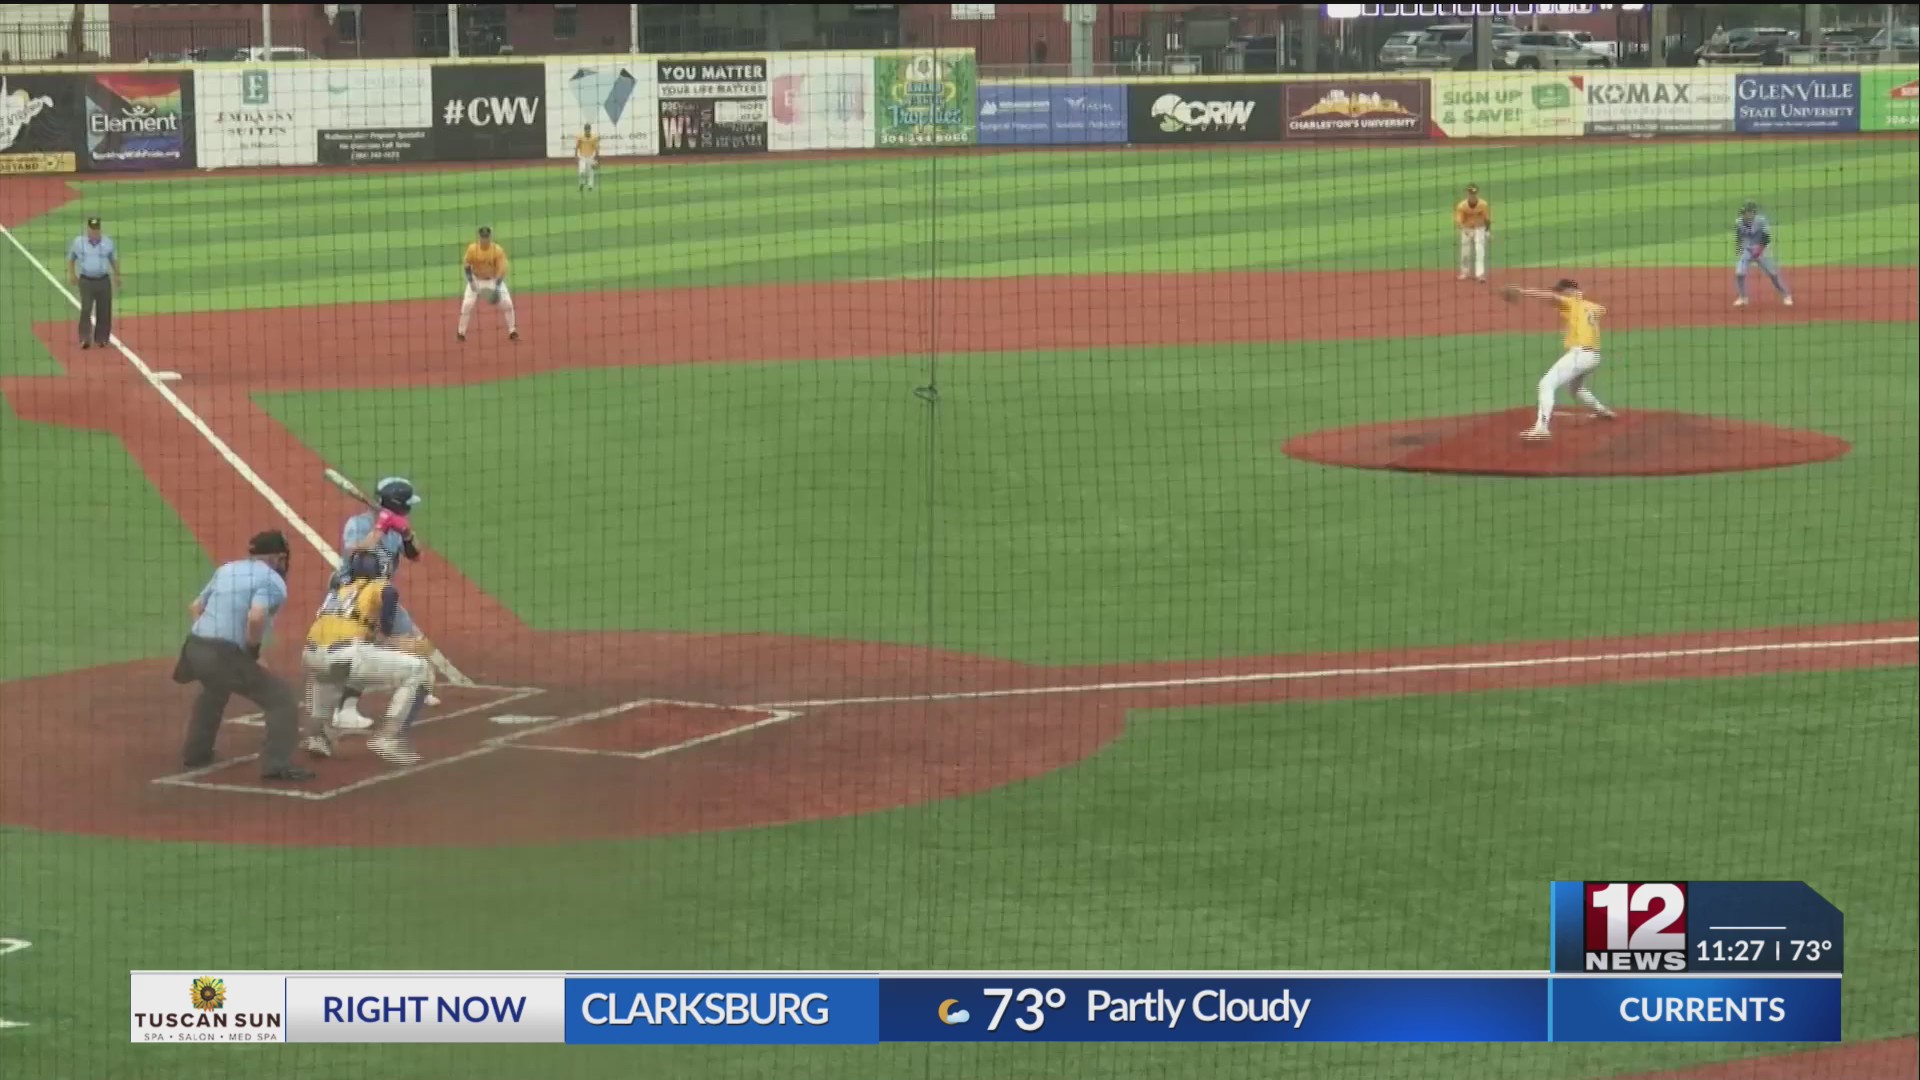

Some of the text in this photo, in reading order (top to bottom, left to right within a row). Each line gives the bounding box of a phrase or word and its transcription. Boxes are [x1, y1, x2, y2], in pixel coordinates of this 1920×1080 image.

[661, 64, 764, 80] YOU MATTER
[247, 74, 264, 100] E
[661, 83, 763, 95] YOUR LIFE MATTERS
[1587, 83, 1689, 104] KOMAX
[1738, 78, 1854, 101] GLENVILLE
[1442, 90, 1522, 106] SIGN UP
[216, 112, 294, 124] EMBASSY
[442, 96, 539, 126] #CWV
[1175, 100, 1257, 125] CRW
[1442, 107, 1521, 124] & SAVE!
[1739, 103, 1855, 118] STATE UNIVERSITY
[90, 112, 179, 133] Element
[1289, 118, 1417, 130] CHARLESTON'S UNIVERSITY
[226, 126, 287, 136] SUITES
